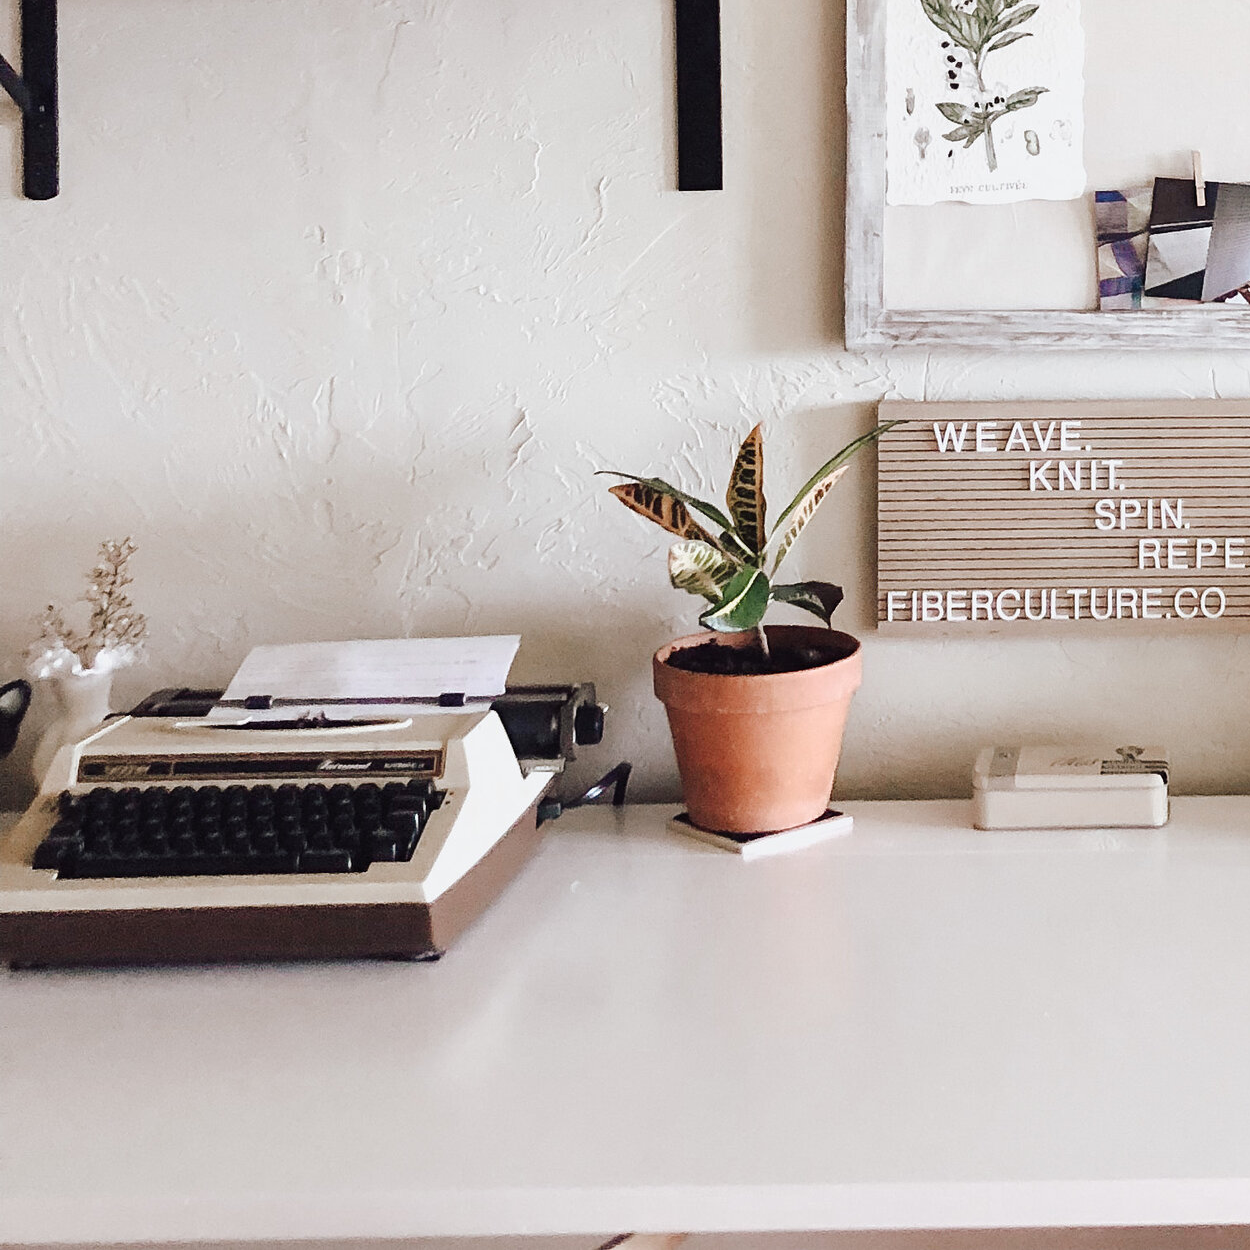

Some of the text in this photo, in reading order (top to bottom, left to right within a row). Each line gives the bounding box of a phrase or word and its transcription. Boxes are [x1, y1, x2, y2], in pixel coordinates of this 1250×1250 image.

[933, 421, 1093, 453] WEAVE.
[1029, 459, 1126, 491] KNIT.
[1094, 498, 1191, 530] SPIN.
[886, 587, 1227, 622] FIBERCULTURE.CO
